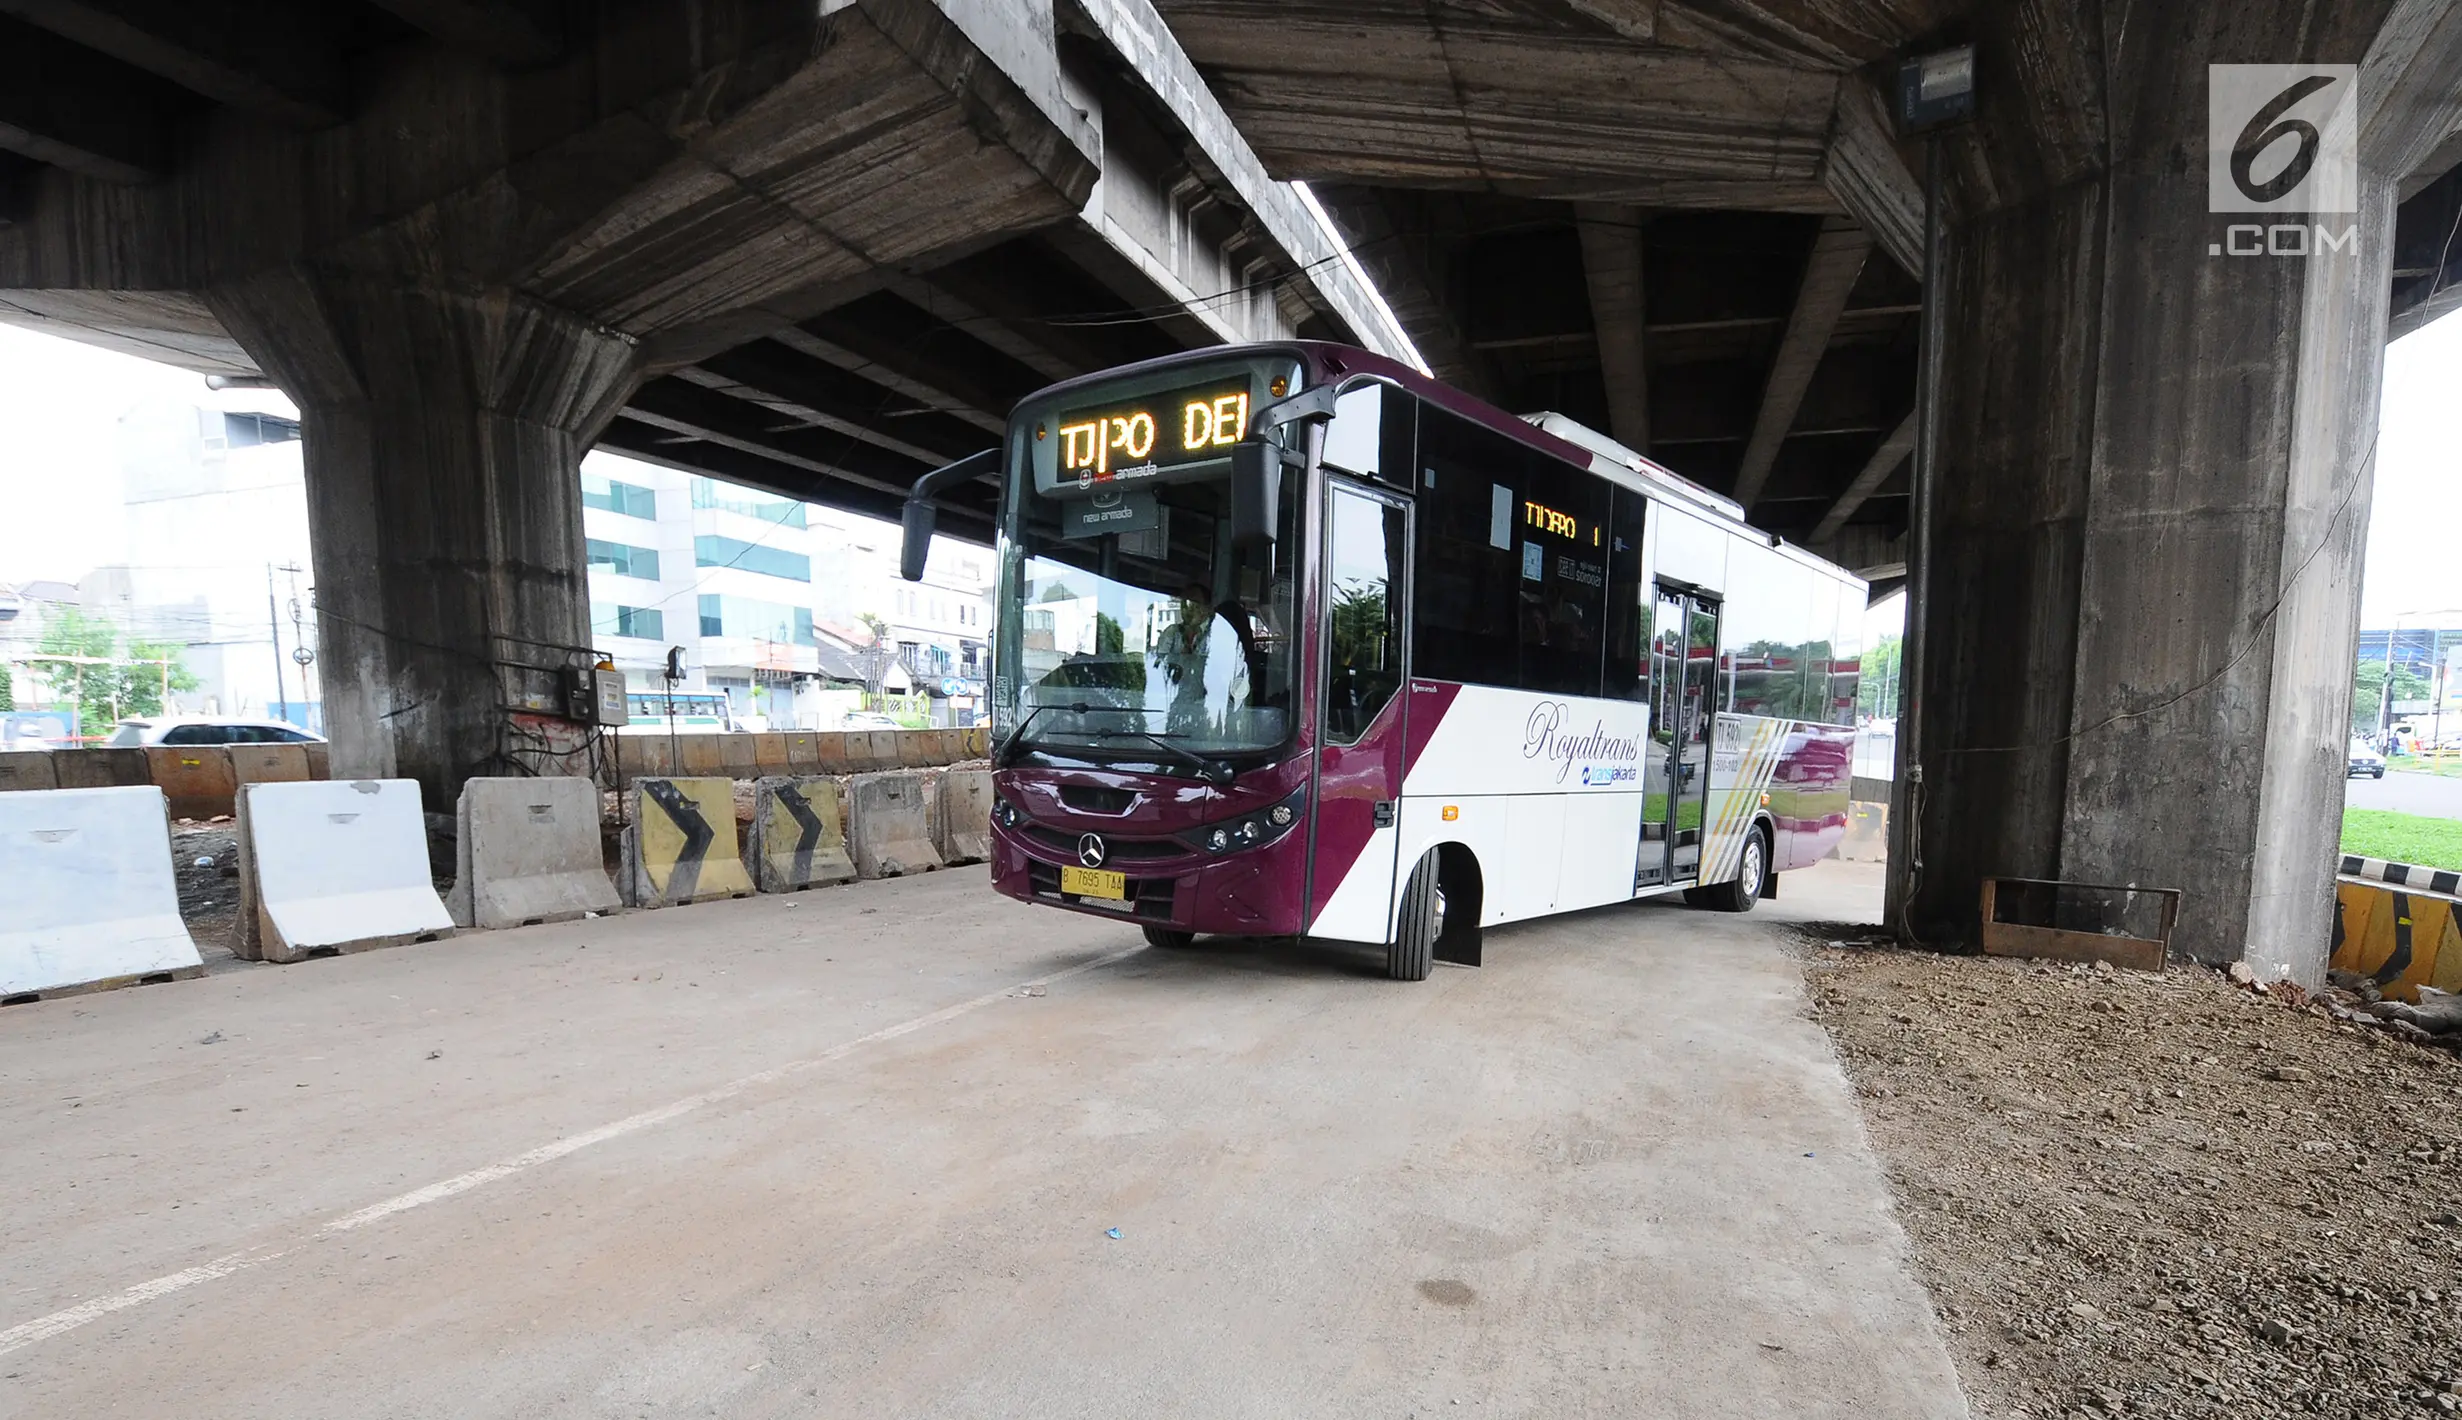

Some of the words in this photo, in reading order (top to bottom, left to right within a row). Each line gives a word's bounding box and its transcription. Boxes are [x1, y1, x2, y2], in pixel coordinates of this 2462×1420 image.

[1115, 460, 1158, 480] armada
[1083, 513, 1100, 524] new
[1101, 506, 1133, 521] armada
[1523, 700, 1640, 785] Royaltrans
[1591, 766, 1638, 786] transjakarta
[1063, 868, 1069, 883] B
[1077, 870, 1100, 888] 7695
[1105, 874, 1123, 890] TAA
